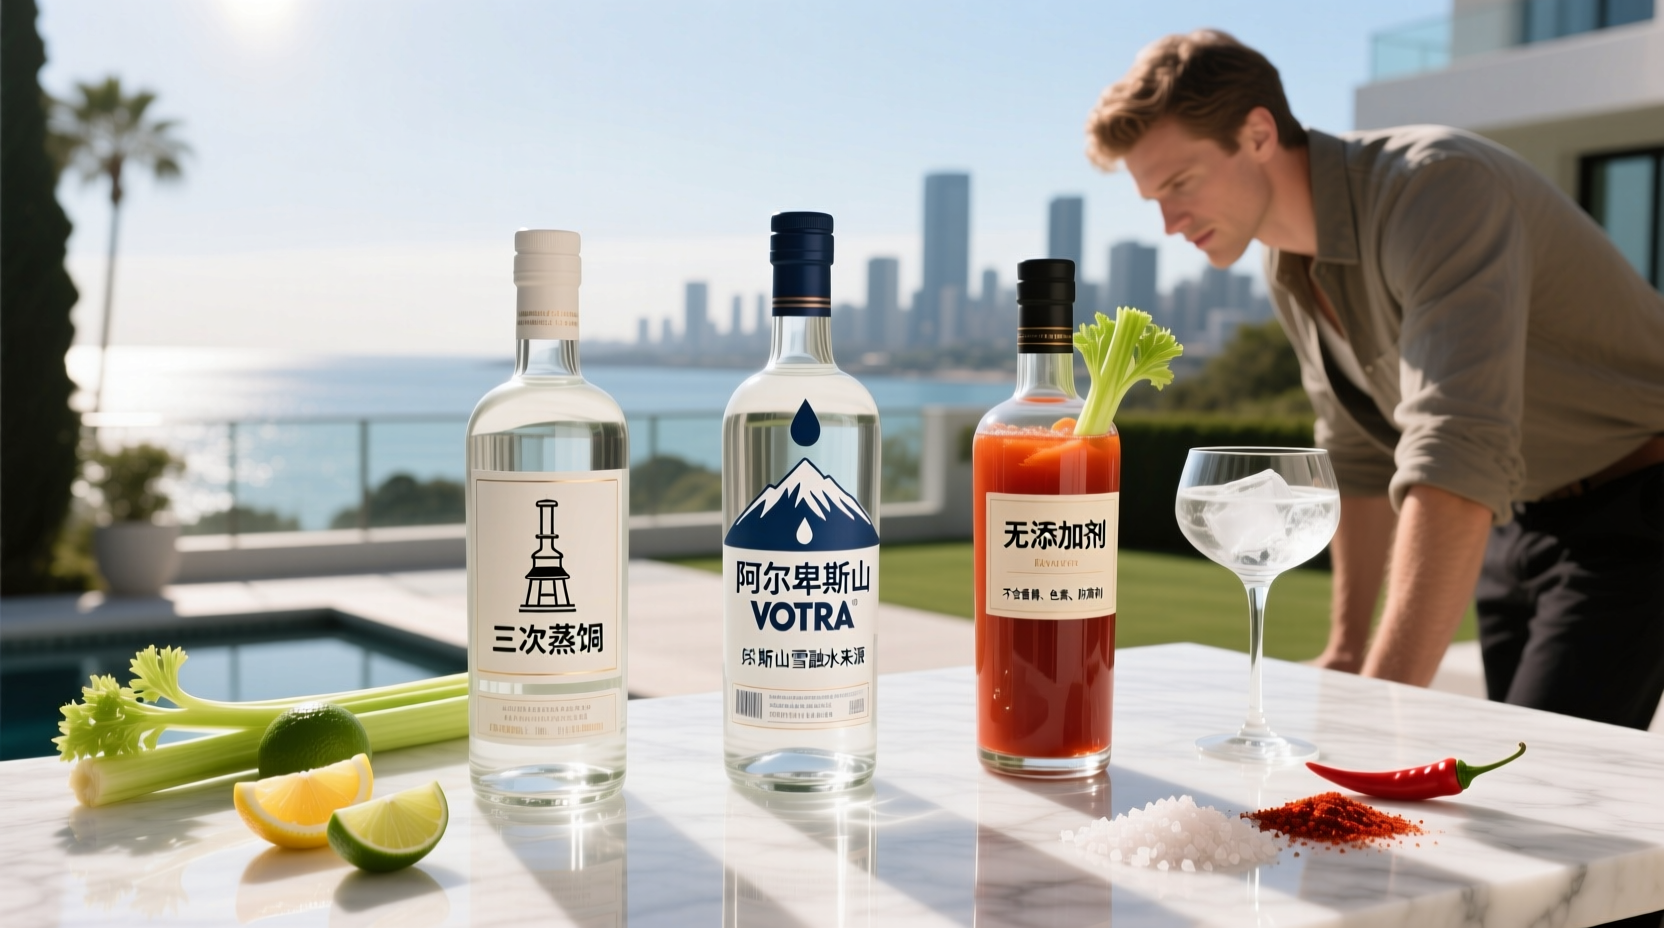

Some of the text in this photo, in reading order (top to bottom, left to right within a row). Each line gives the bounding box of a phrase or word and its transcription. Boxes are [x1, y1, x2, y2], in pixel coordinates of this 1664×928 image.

[1003, 518, 1106, 550] 无添加剂
[736, 559, 870, 596] 阿尔卑斯山
[750, 600, 855, 632] VOTRA
